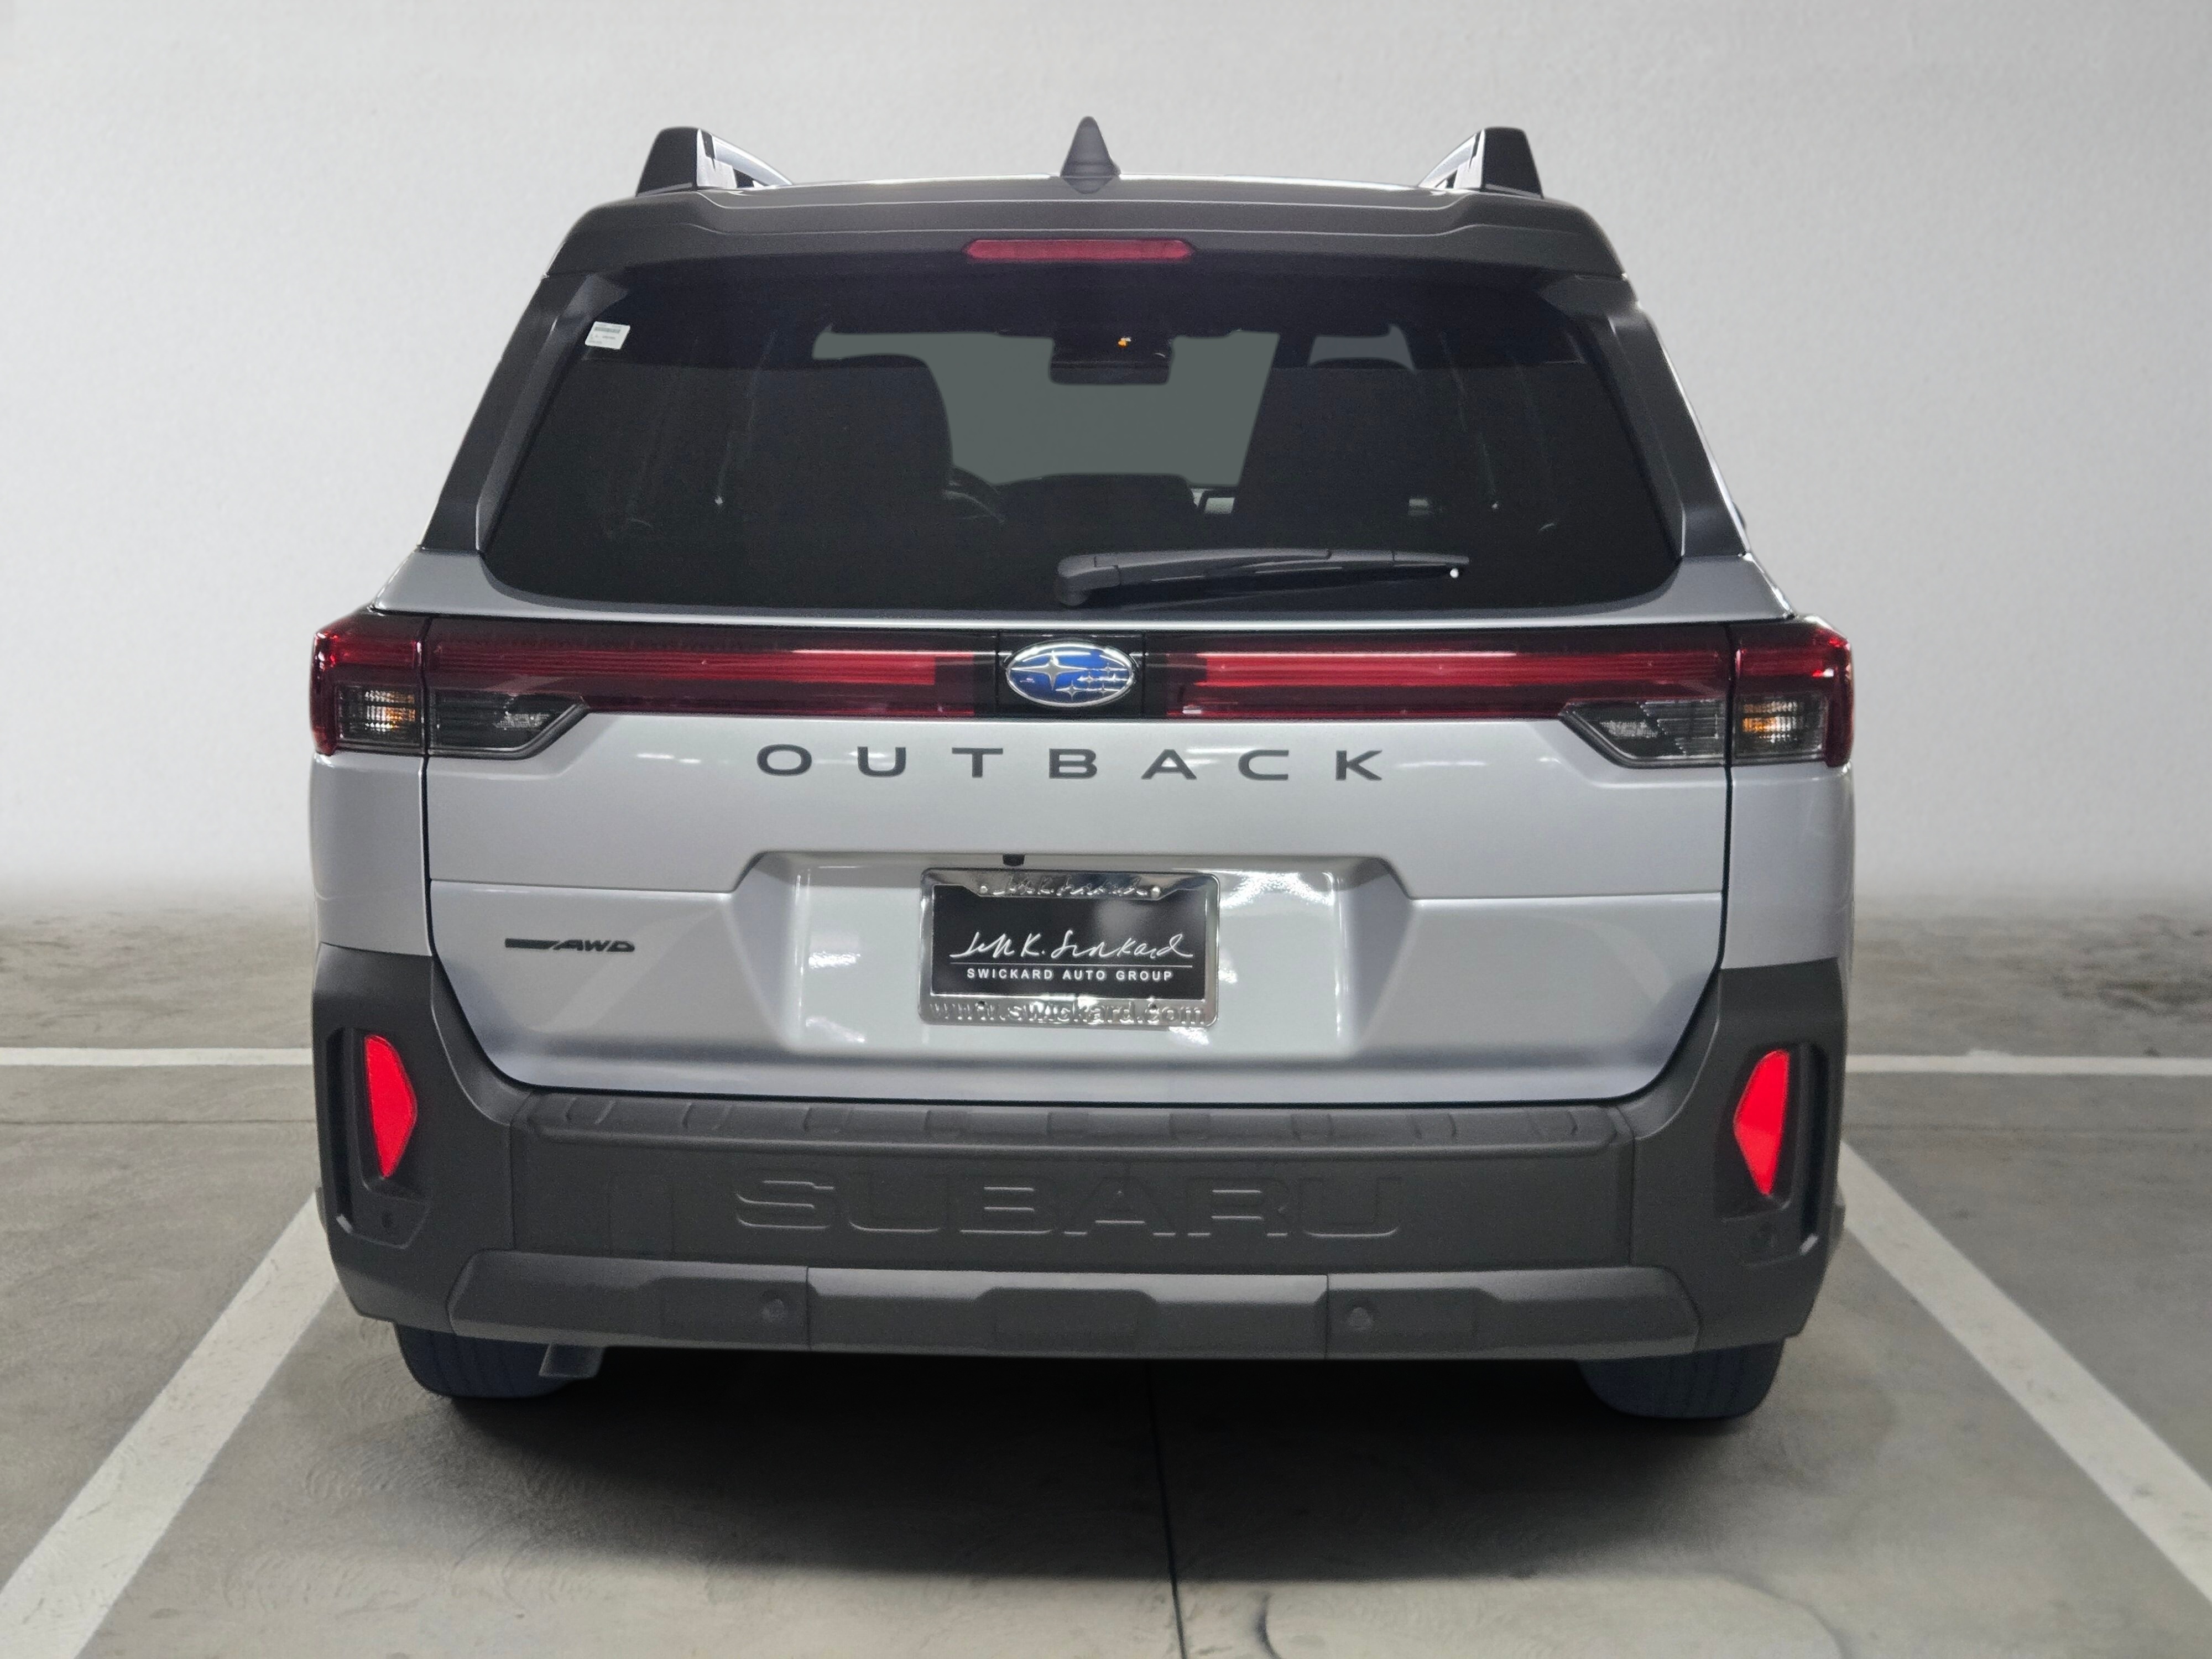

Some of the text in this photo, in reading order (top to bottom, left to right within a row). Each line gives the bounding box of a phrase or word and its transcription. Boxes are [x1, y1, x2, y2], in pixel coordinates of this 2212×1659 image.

[756, 743, 1383, 781] OUTBACK
[552, 938, 635, 952] AWD
[967, 967, 1173, 982] SWICKARD AUTO GROUP
[734, 1168, 1402, 1238] SUBARU
